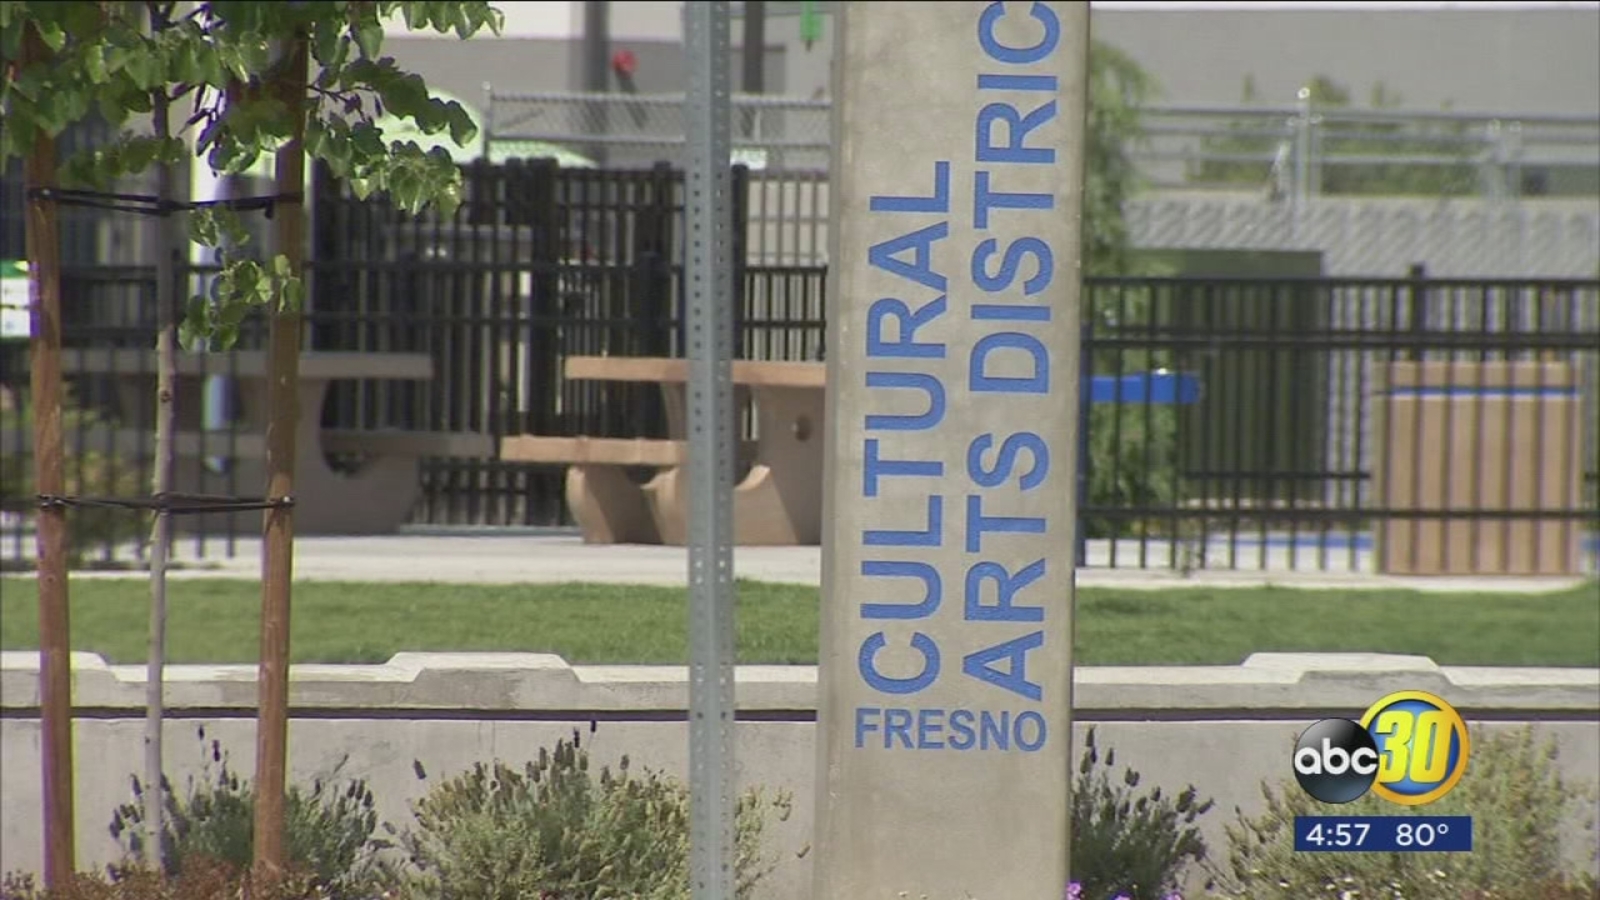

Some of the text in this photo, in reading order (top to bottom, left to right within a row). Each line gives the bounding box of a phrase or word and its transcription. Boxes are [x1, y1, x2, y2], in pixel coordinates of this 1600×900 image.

[859, 161, 952, 695] CULTURAL
[963, 1, 1061, 701] ARTS DISTRIC
[855, 708, 1047, 751] FRESNO
